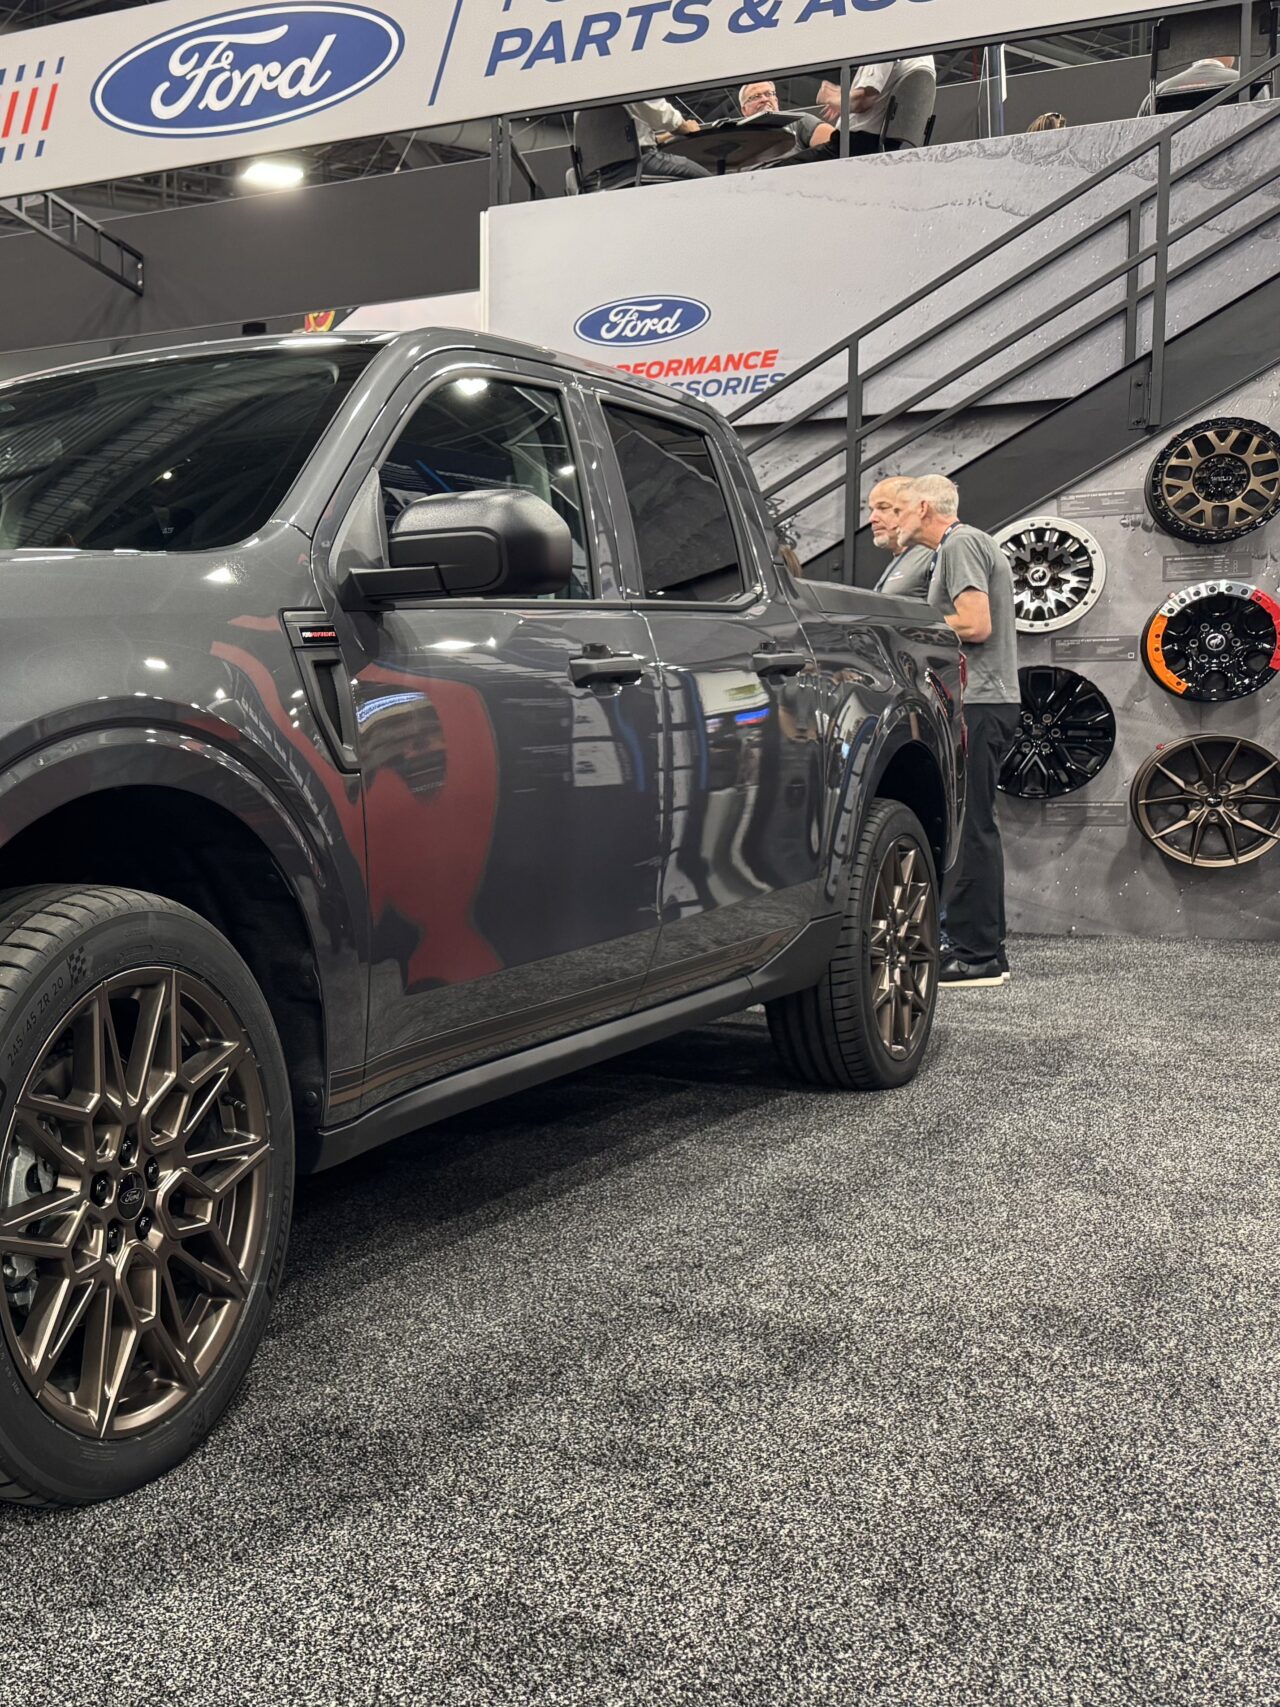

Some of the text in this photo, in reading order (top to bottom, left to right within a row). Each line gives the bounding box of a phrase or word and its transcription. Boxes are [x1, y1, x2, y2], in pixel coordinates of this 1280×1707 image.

[484, 0, 710, 77] PARTS
[726, 0, 780, 34] &
[151, 24, 337, 119] Ford
[600, 303, 683, 340] Ford
[615, 349, 779, 379] FORMANCE
